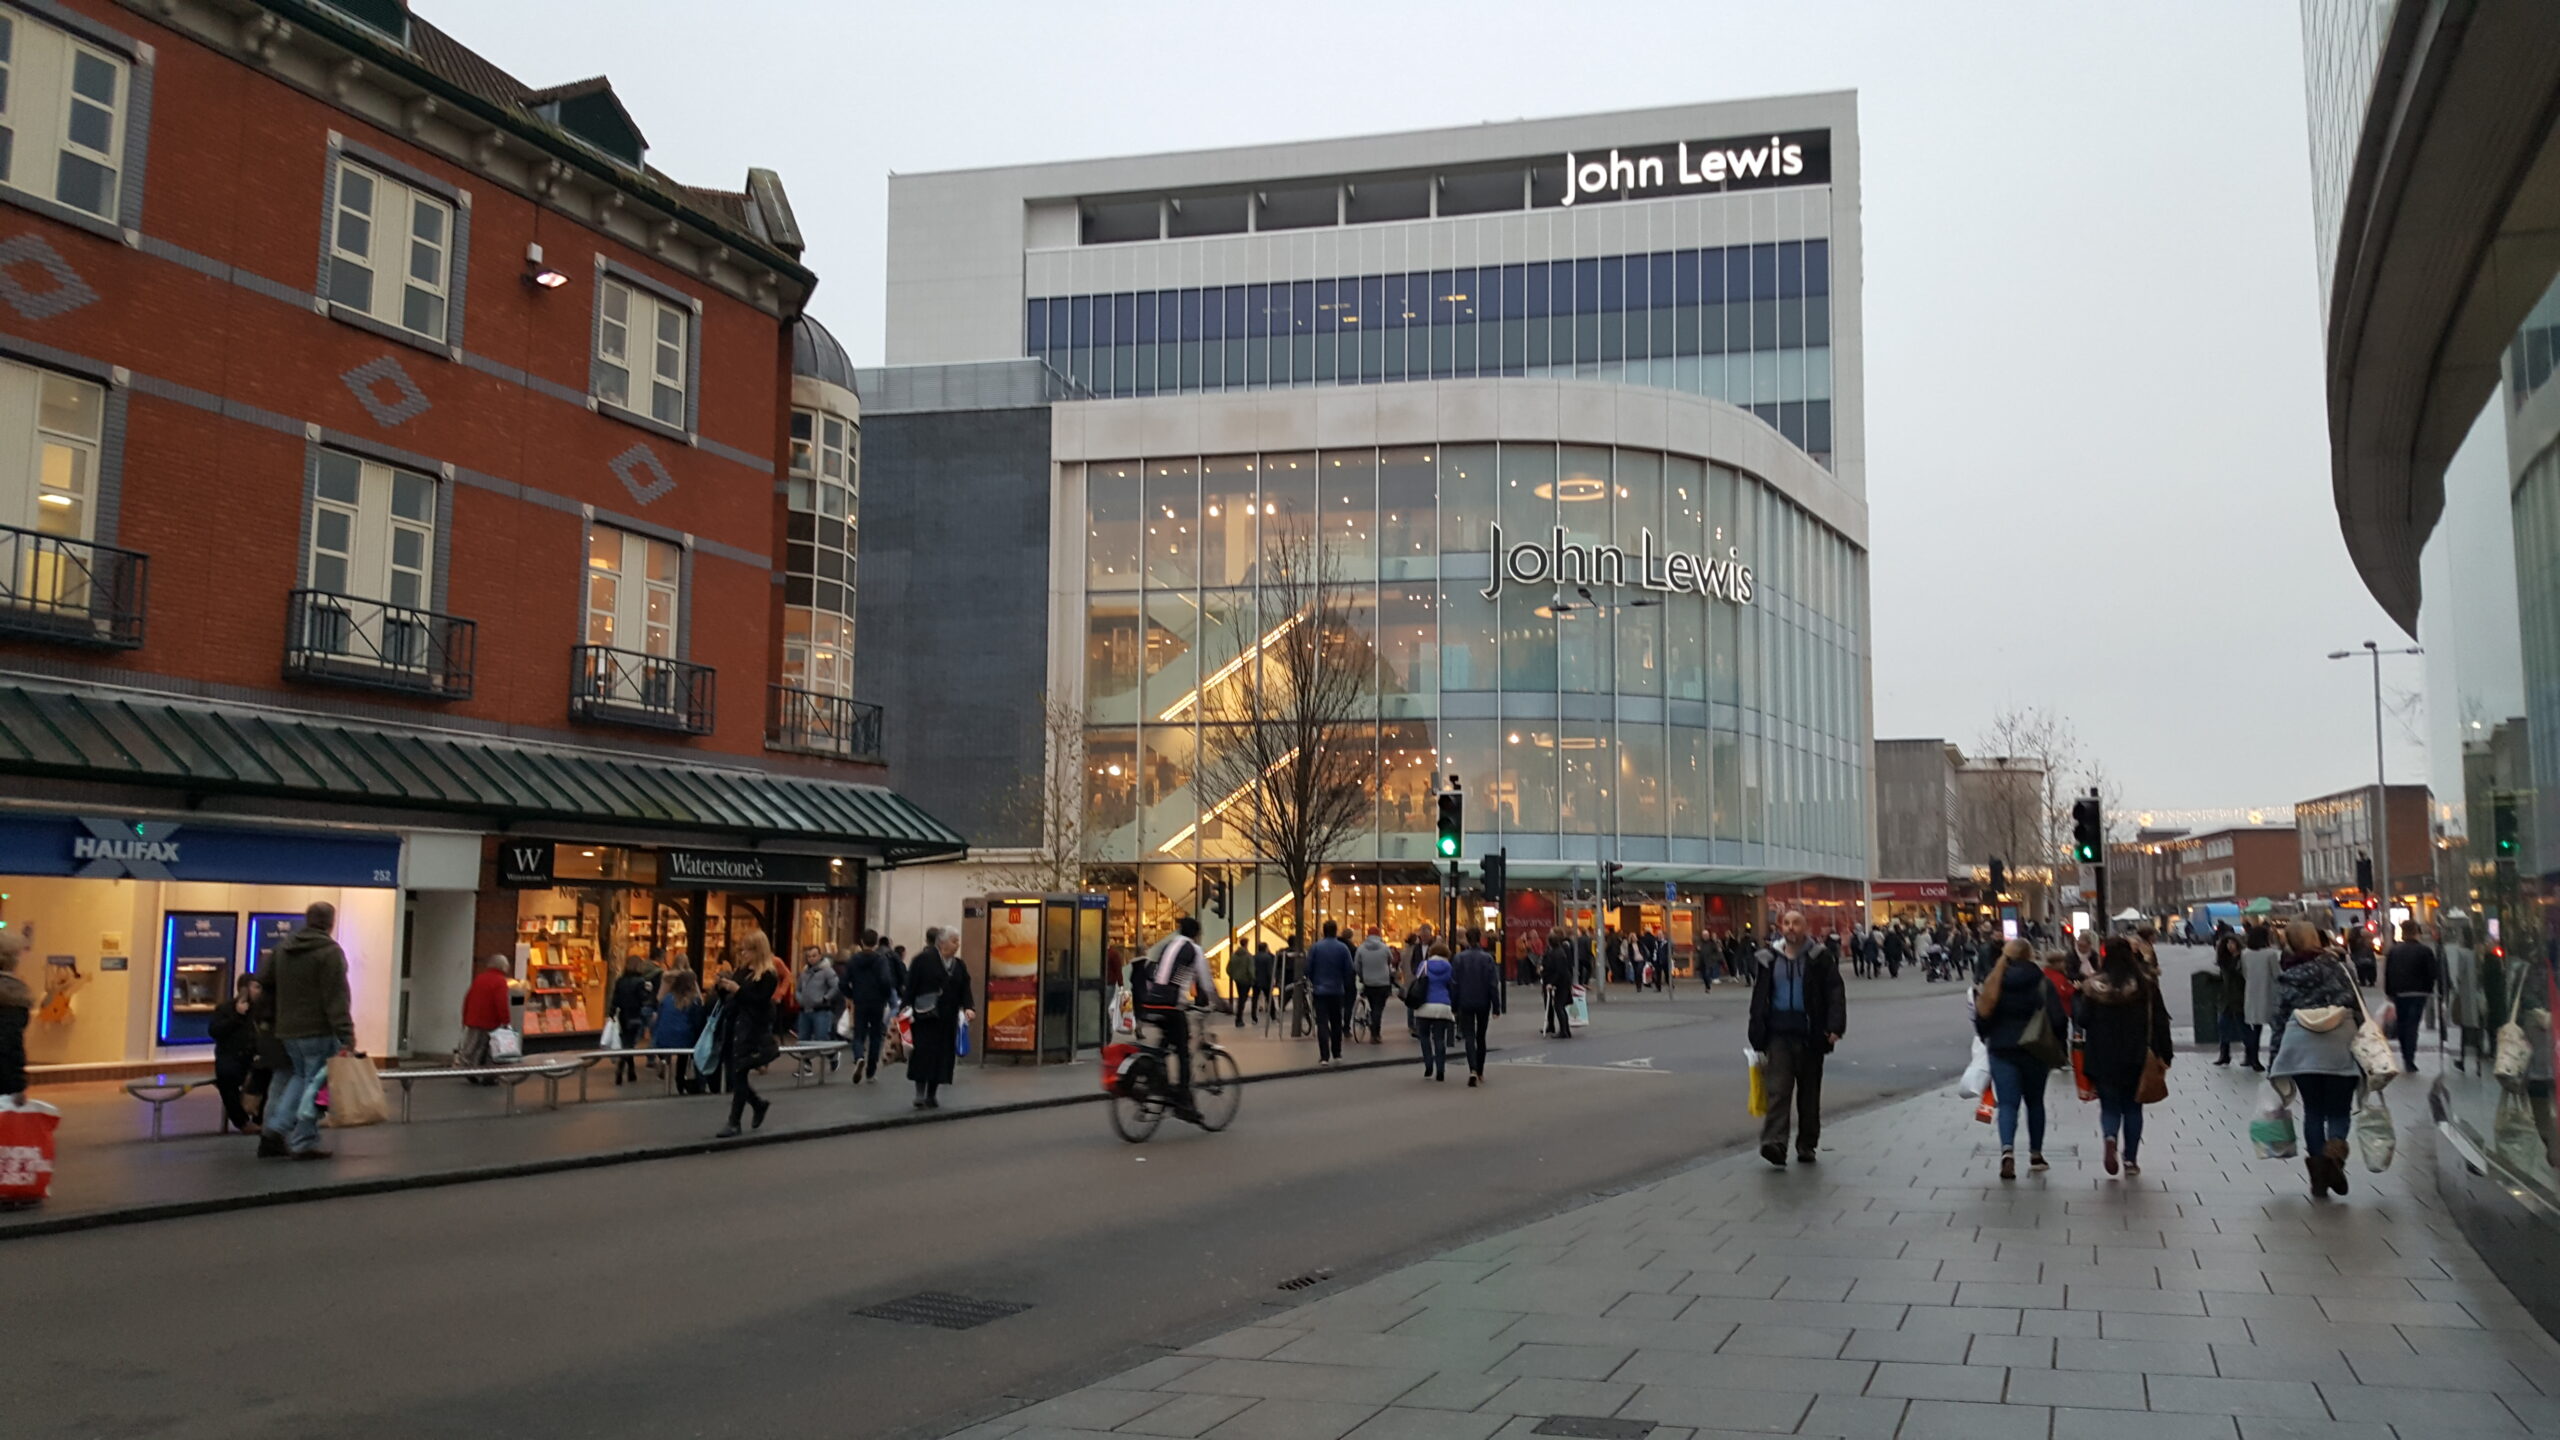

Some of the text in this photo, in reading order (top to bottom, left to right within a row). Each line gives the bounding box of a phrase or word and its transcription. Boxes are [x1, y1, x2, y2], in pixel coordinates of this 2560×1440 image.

[1561, 135, 1804, 207] John Lewis
[1479, 520, 1753, 604] John Lewis
[74, 837, 180, 862] HALIFAX
[512, 847, 544, 872] W
[671, 852, 764, 878] Waterstone's
[1920, 884, 1947, 897] Local
[1505, 916, 1552, 928] Clearance
